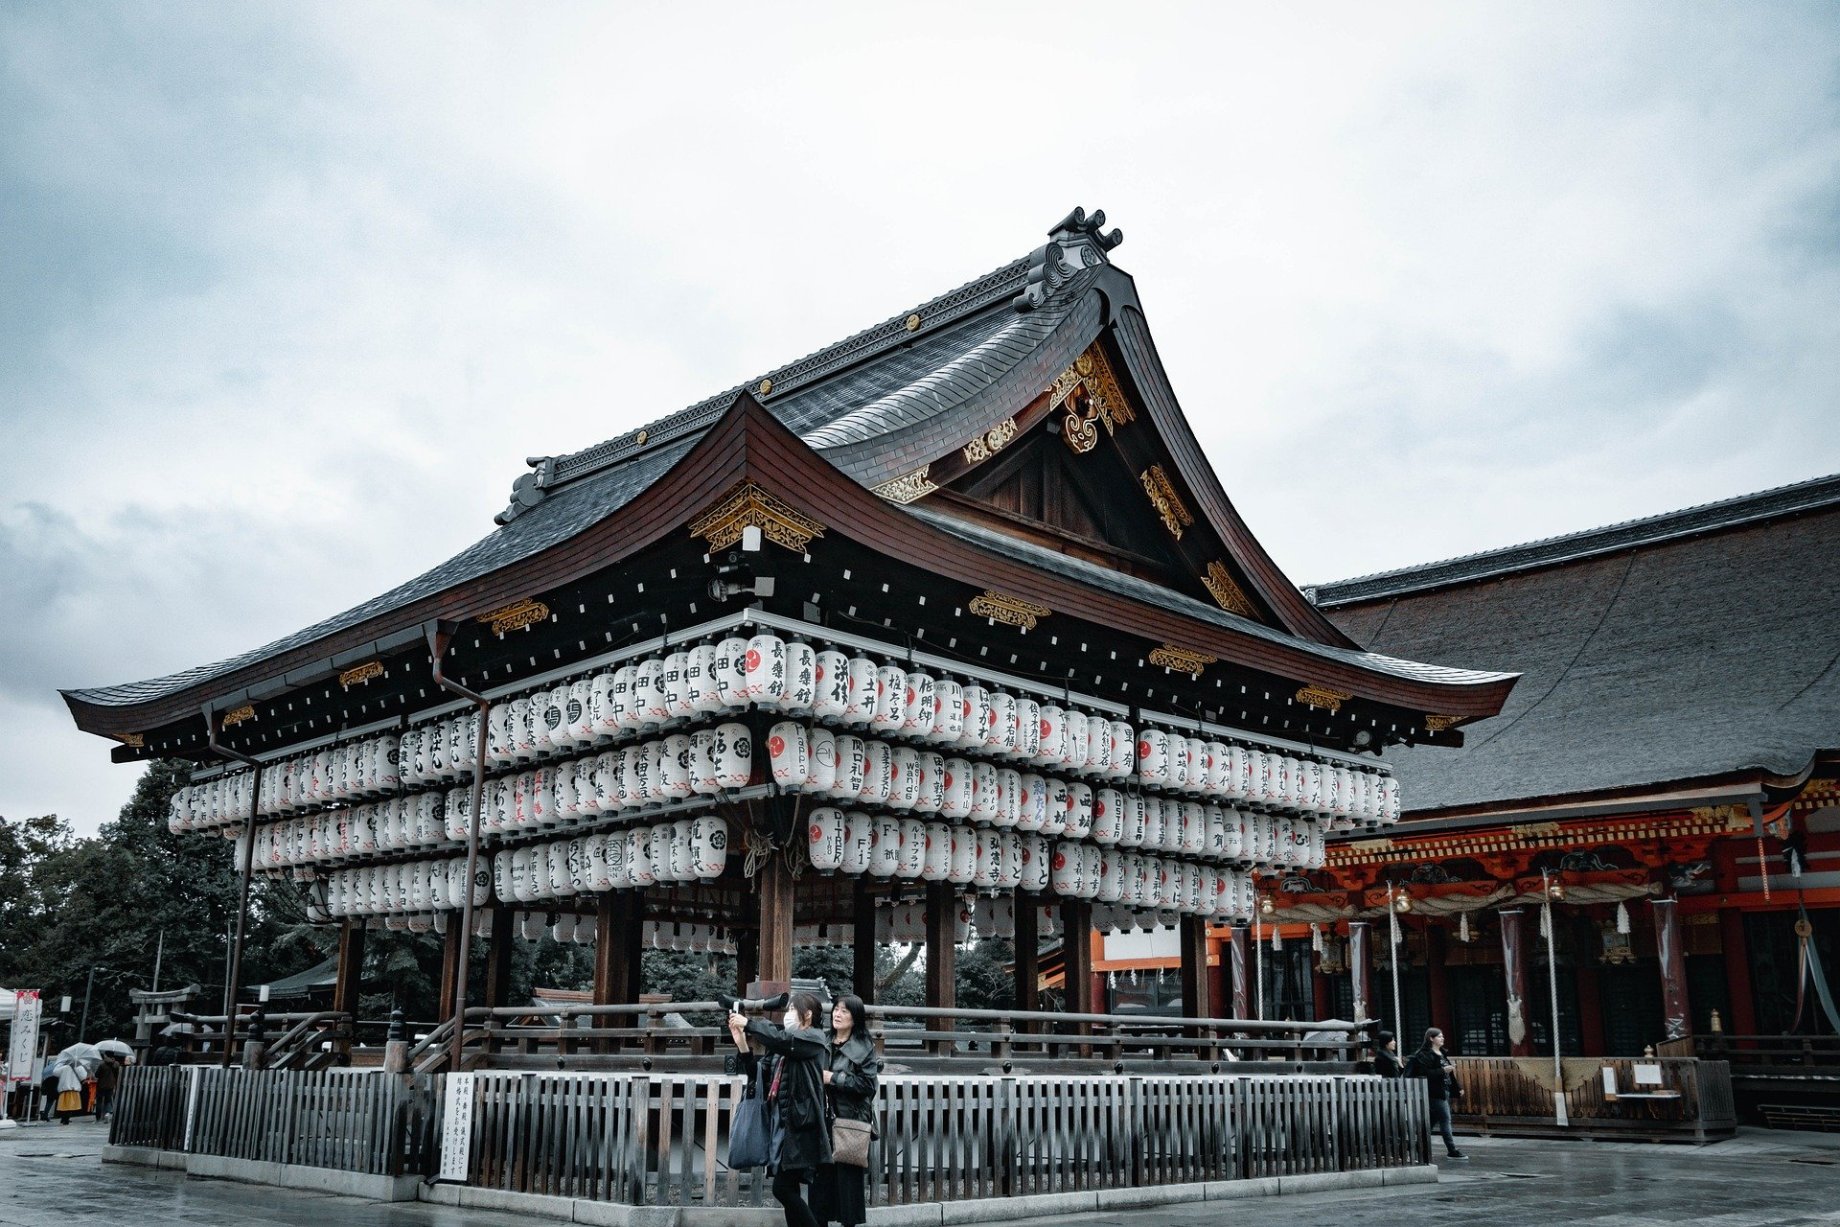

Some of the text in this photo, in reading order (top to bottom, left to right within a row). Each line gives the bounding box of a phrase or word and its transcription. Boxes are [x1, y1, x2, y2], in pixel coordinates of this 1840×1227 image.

[636, 677, 649, 716] 田中
[666, 671, 679, 711] 田中
[689, 667, 700, 702] 田中
[861, 678, 876, 714] 土井
[979, 689, 990, 740] はやかわ
